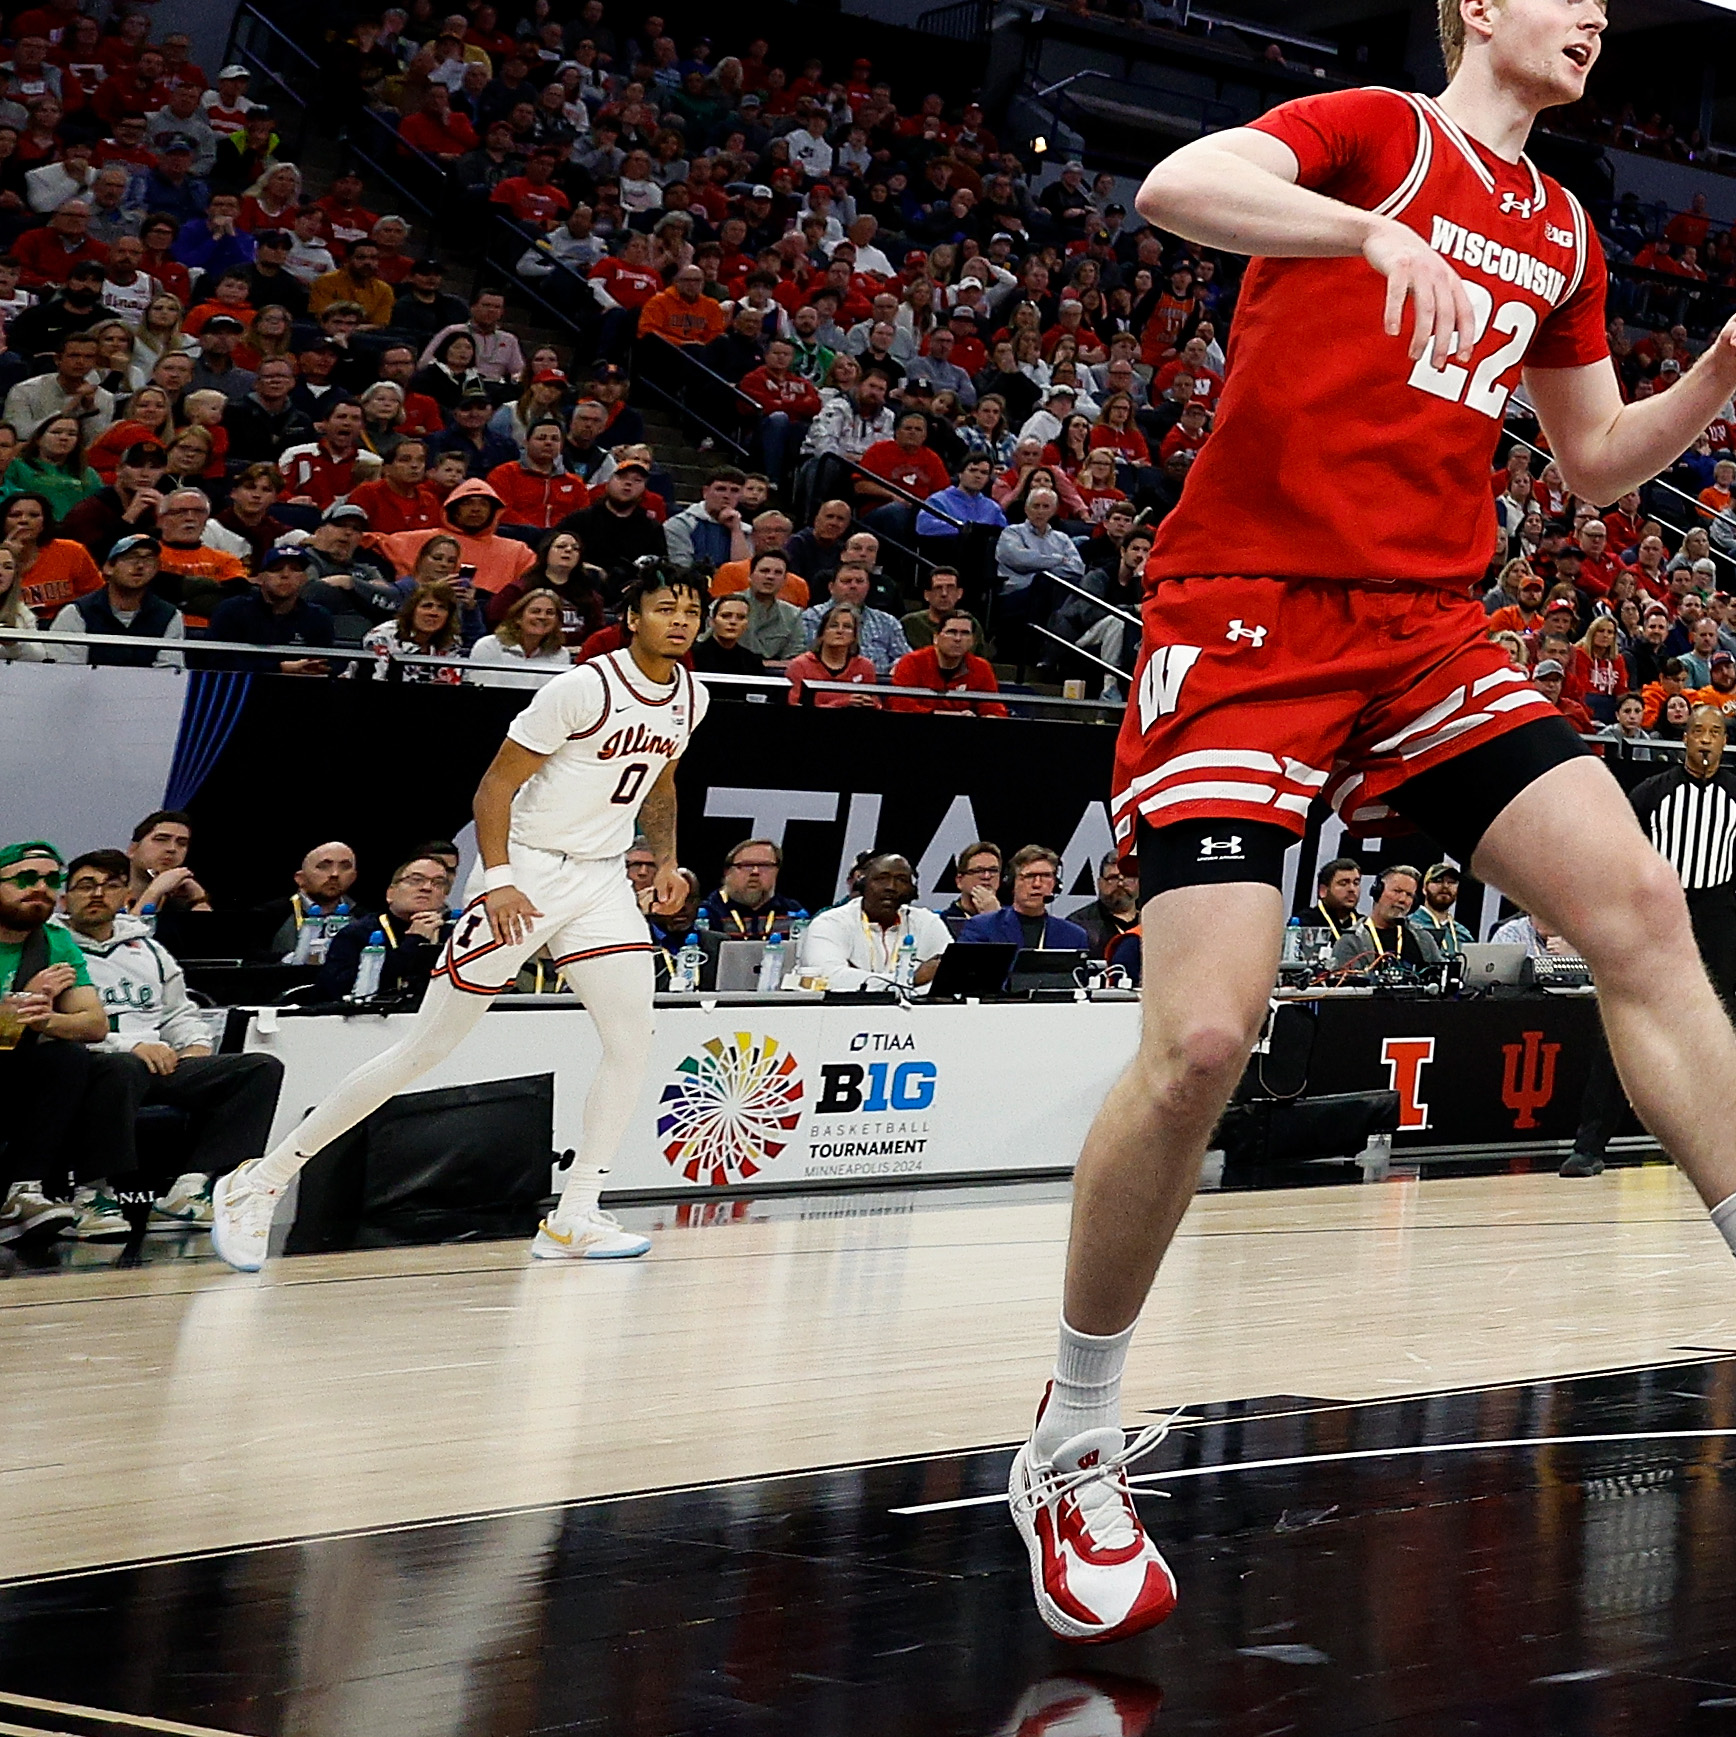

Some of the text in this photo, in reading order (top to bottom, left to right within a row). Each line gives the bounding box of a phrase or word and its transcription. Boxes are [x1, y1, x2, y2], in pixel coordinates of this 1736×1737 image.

[1430, 215, 1567, 307] WISCONSIN
[1406, 278, 1538, 420] 22
[1138, 644, 1203, 736] W
[597, 723, 680, 761] Illinoi
[610, 762, 649, 805] 0
[703, 788, 1118, 916] TIAA
[455, 913, 483, 949] I
[872, 1032, 916, 1052] TIAA
[809, 1138, 928, 1159] TOURNAMENT
[810, 1121, 930, 1138] BASKETBALL
[804, 1159, 923, 1178] MINNEAPOLIS 2024
